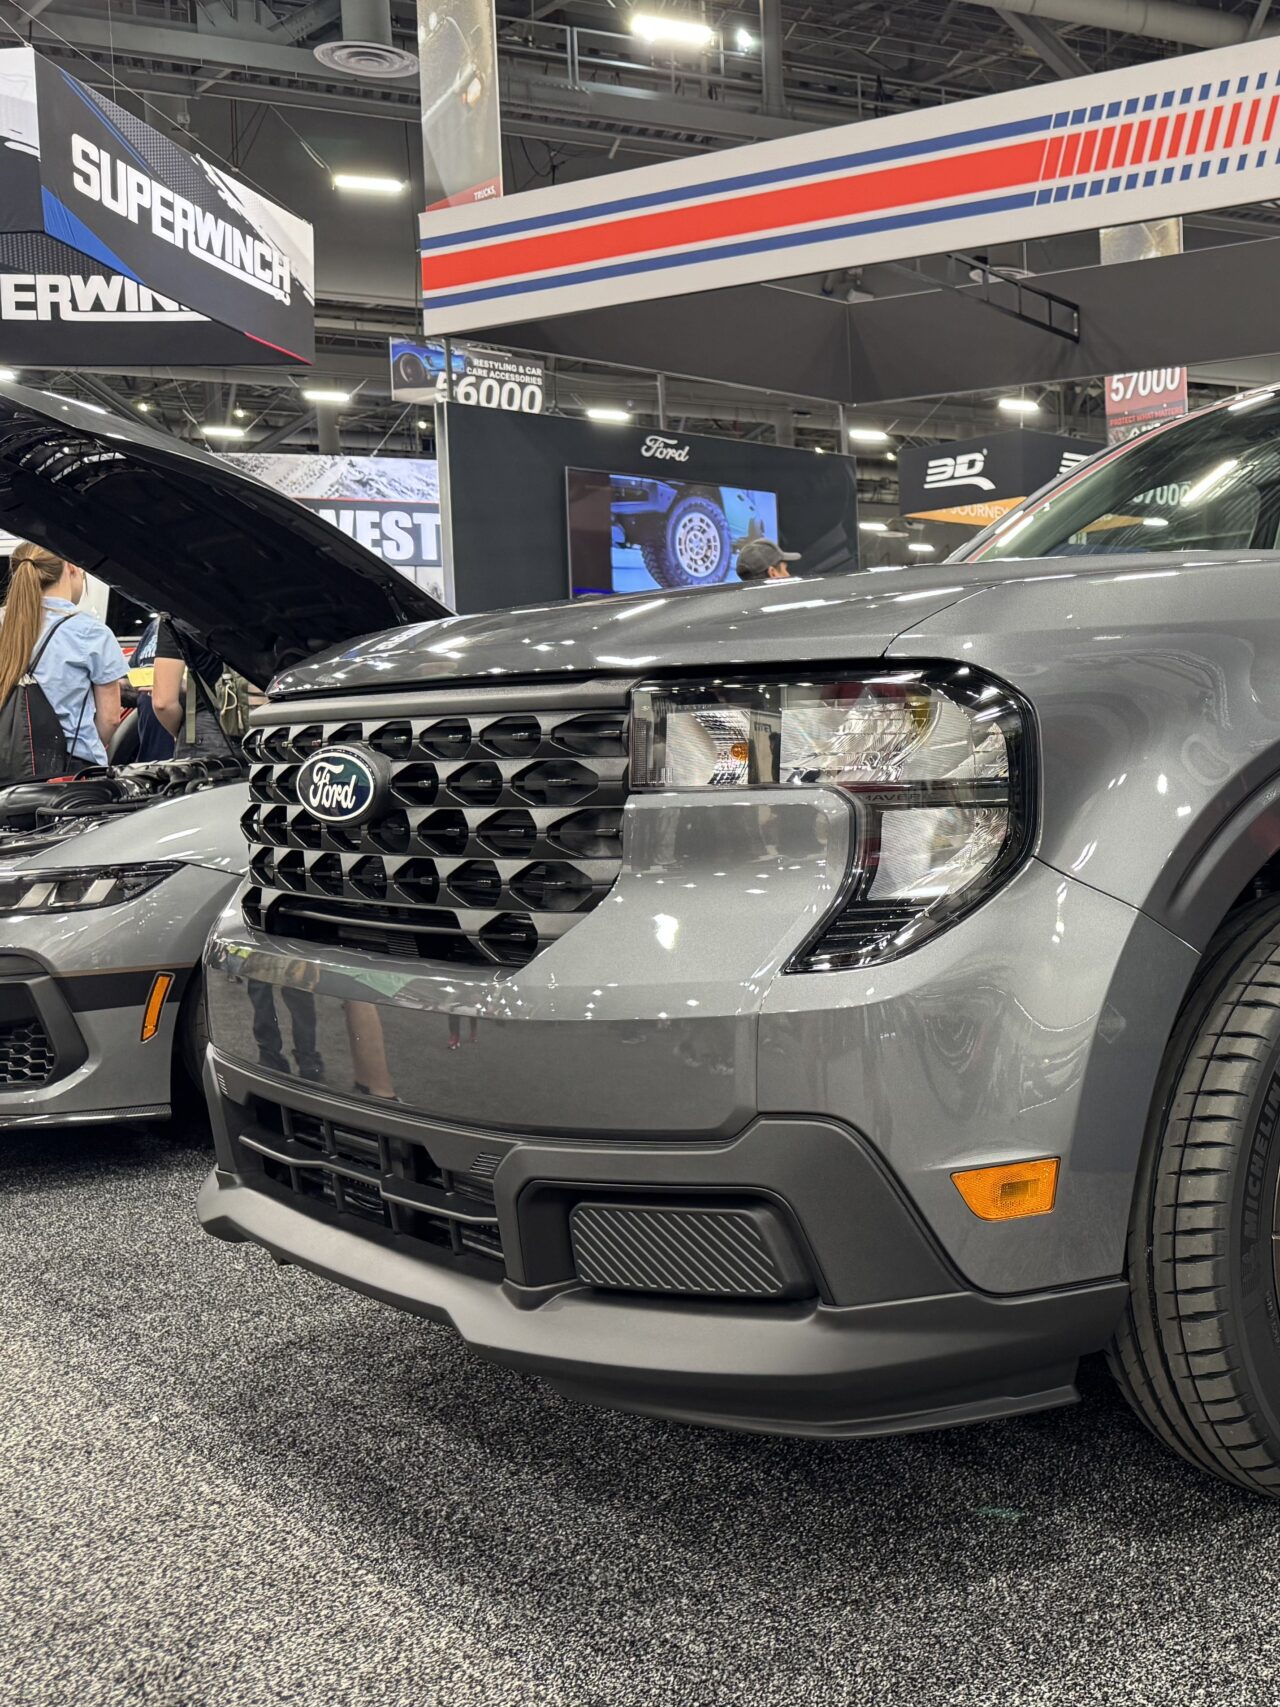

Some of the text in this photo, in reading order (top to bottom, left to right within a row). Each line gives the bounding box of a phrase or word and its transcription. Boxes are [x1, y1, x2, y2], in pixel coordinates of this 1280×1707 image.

[71, 133, 291, 305] SUPERWINCH
[0, 274, 203, 321] ERWIN
[466, 366, 543, 385] CARE ACCESSORIES
[473, 358, 542, 376] RESTYLING & CAR
[1110, 367, 1181, 402] 57000
[641, 435, 690, 462] Ford
[925, 452, 985, 482] 3D
[309, 761, 357, 809] Ford
